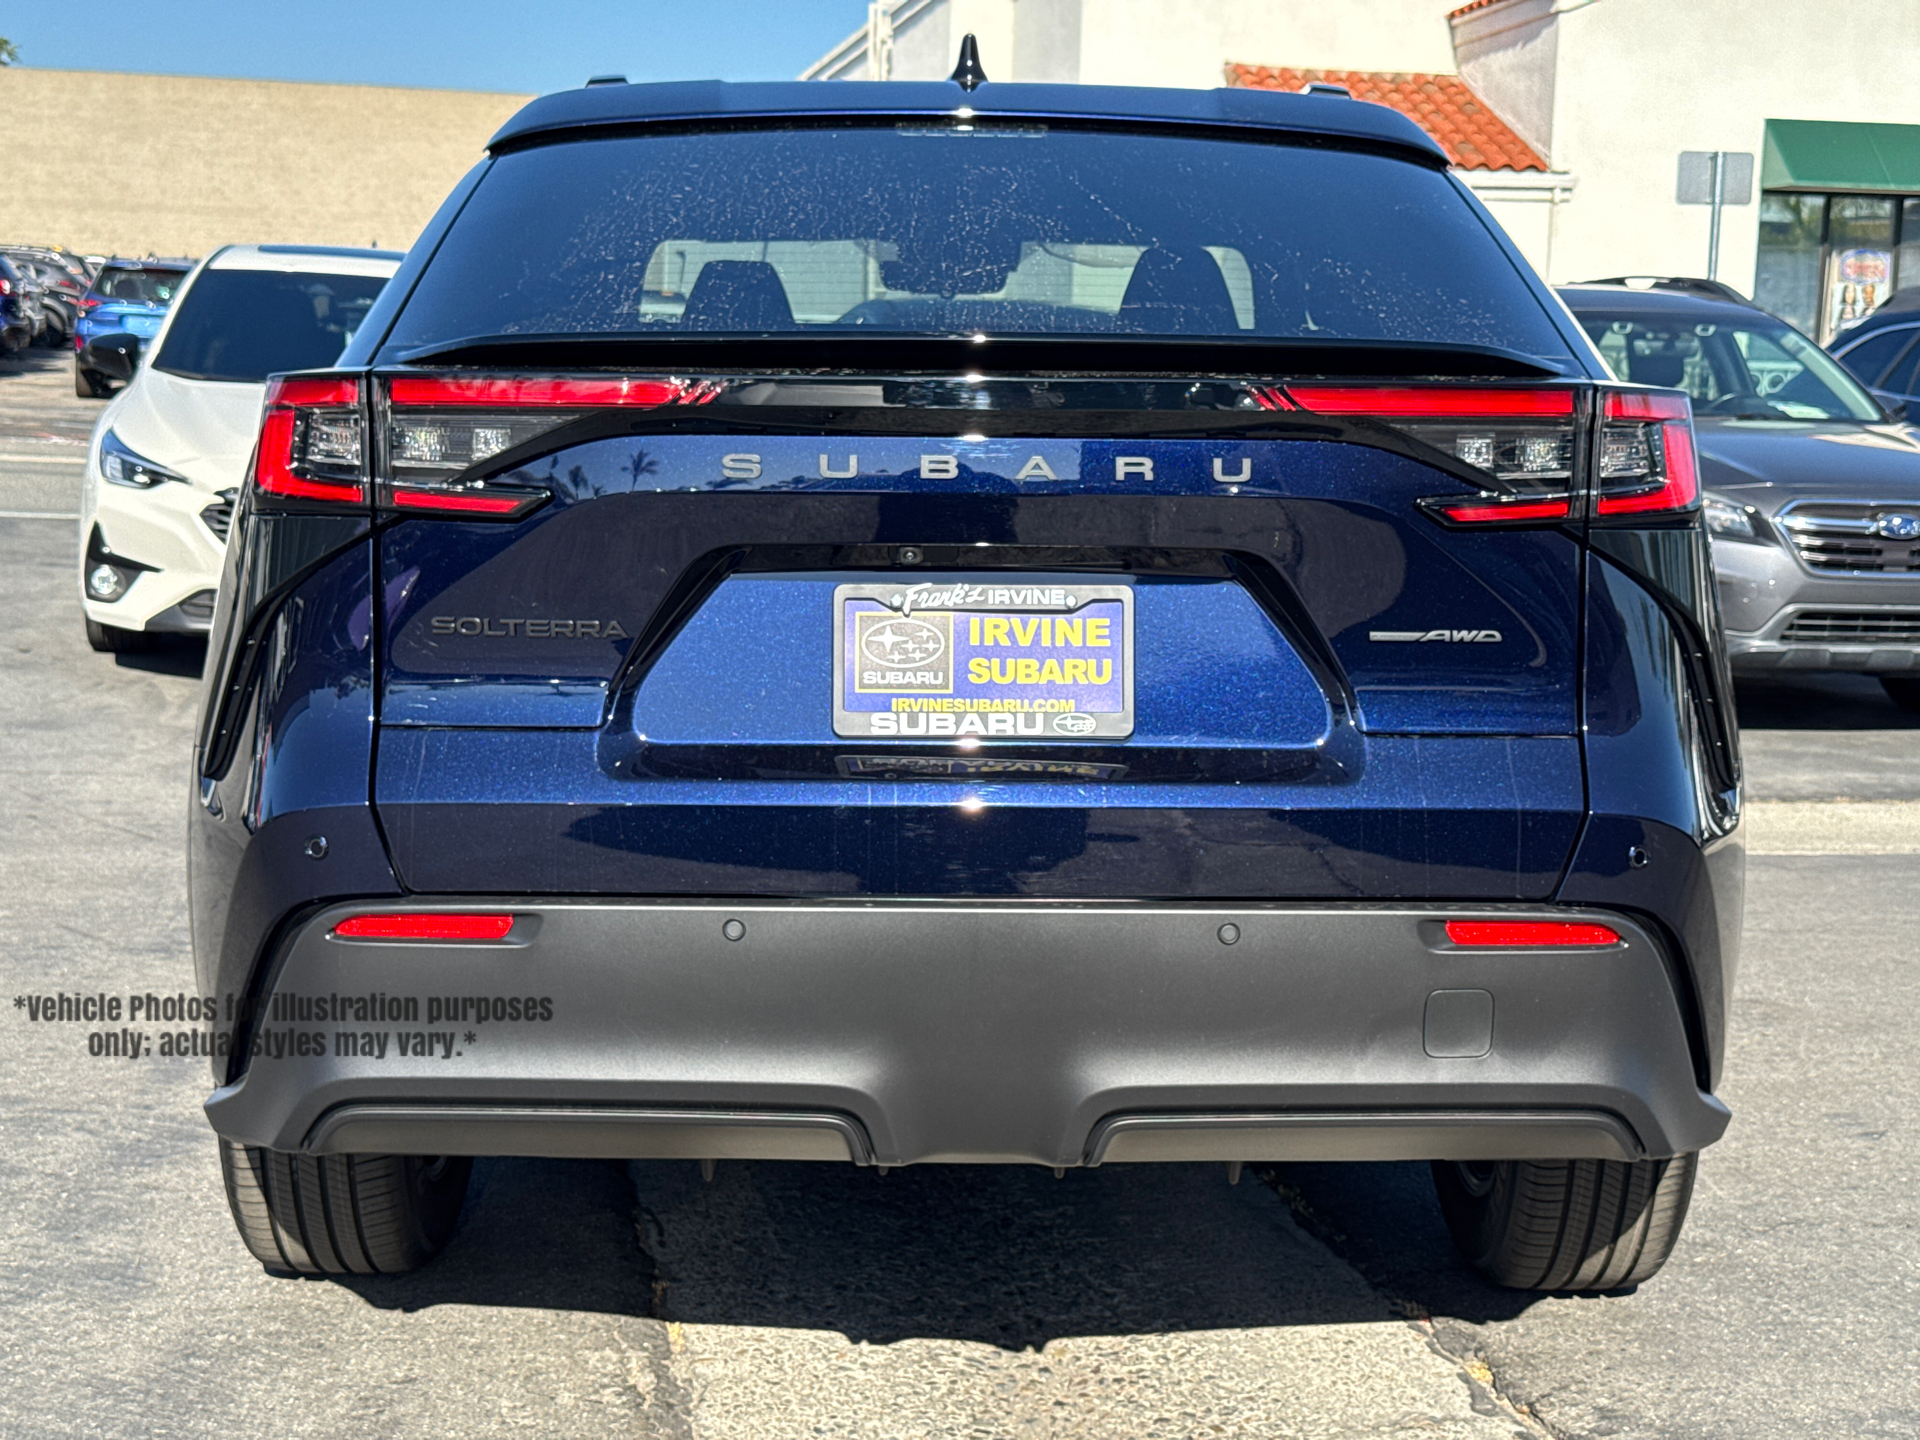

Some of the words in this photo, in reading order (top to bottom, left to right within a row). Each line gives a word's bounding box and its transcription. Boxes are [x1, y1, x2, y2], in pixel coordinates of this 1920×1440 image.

[721, 453, 1252, 483] SUBARU
[902, 583, 985, 618] Frank's
[988, 589, 1066, 605] IRVINE
[430, 616, 628, 639] SOLTERRA
[969, 617, 1111, 647] IRVINE
[1419, 629, 1503, 643] AWD
[862, 671, 944, 686] SUBARU
[968, 658, 1112, 685] SUBARU
[891, 698, 1076, 712] IRVINESUBARU.COM
[870, 712, 1045, 735] SUBARU
